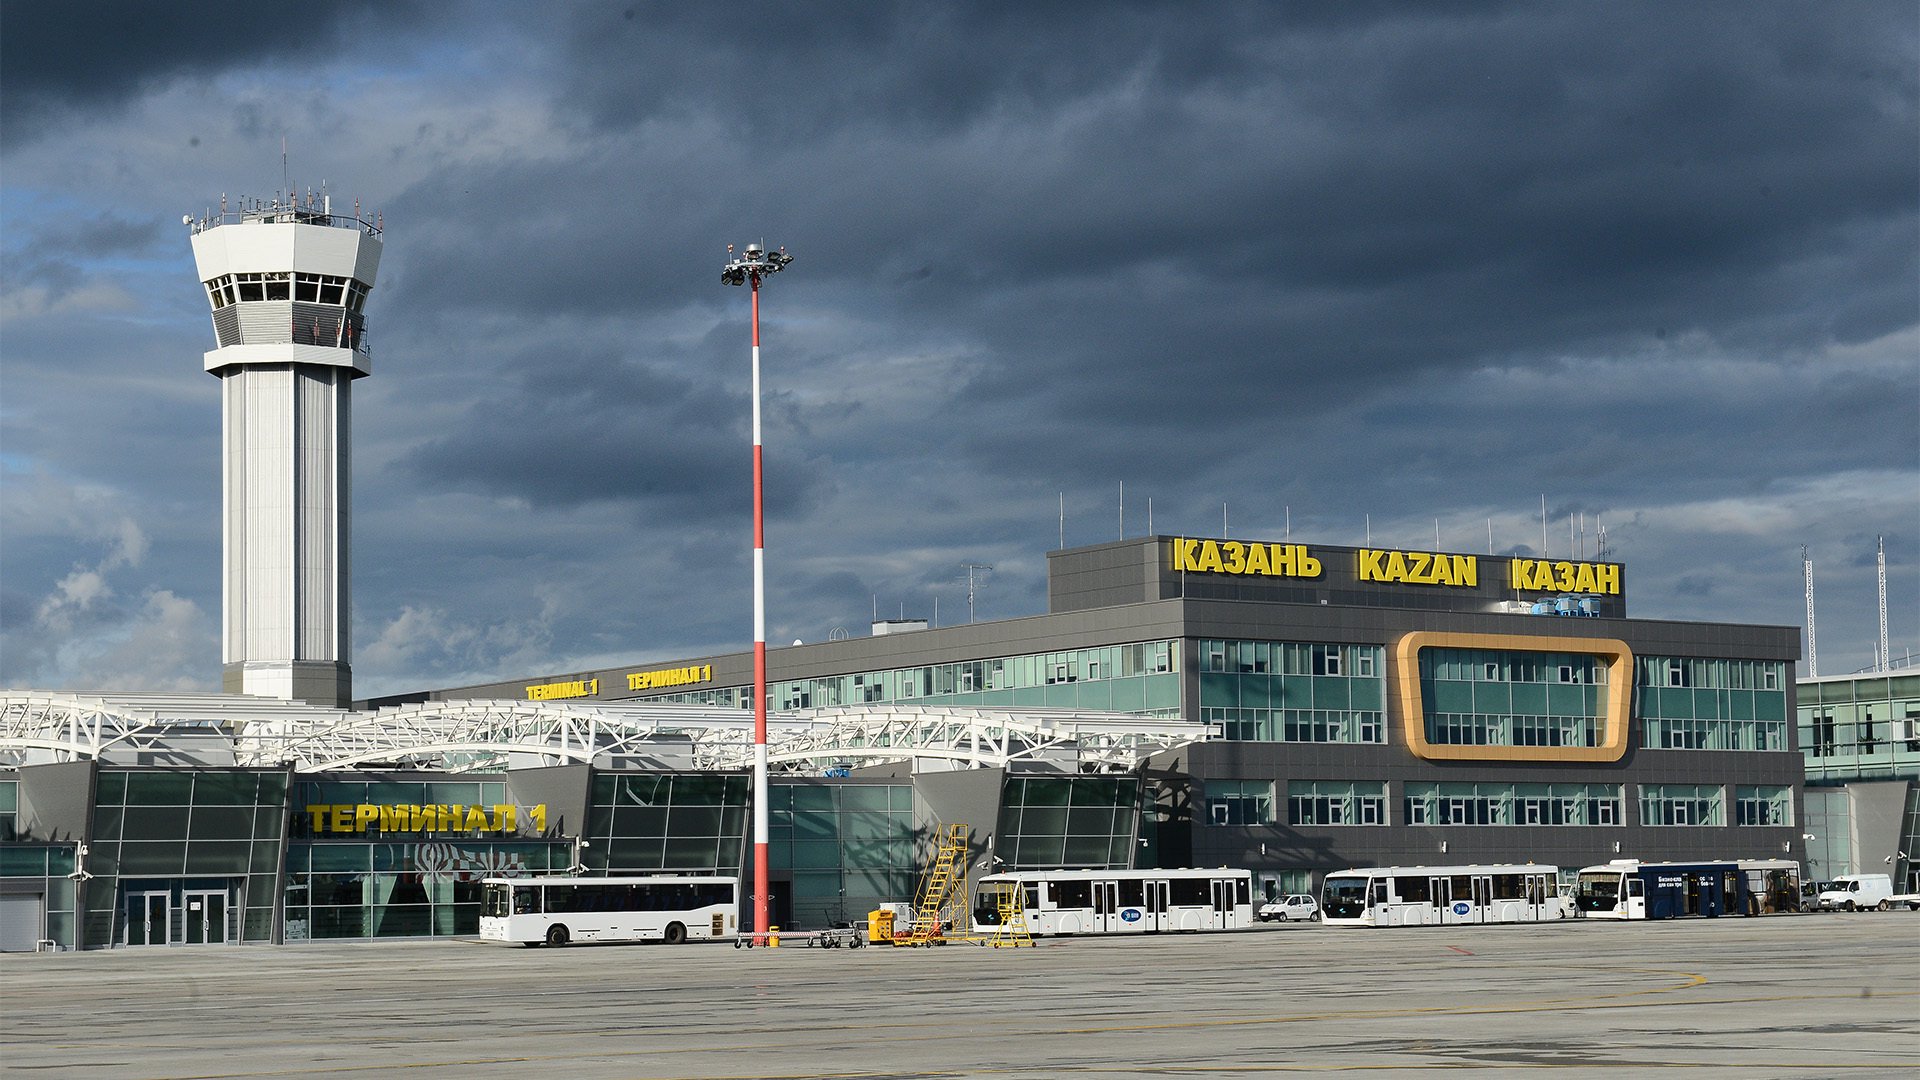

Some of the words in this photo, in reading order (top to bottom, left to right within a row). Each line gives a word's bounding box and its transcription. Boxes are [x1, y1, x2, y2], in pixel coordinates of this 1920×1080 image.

[1174, 538, 1322, 578] КАЗАНЬ
[1360, 549, 1477, 587] KAZAN
[1512, 559, 1620, 595] КАЗАН
[526, 680, 588, 700] TERMINAL
[590, 678, 599, 696] 1
[627, 666, 701, 691] ТЕРМИНАЛ
[703, 664, 712, 682] 1
[306, 804, 517, 833] ТЕРМИНАЛ
[530, 804, 547, 832] 1
